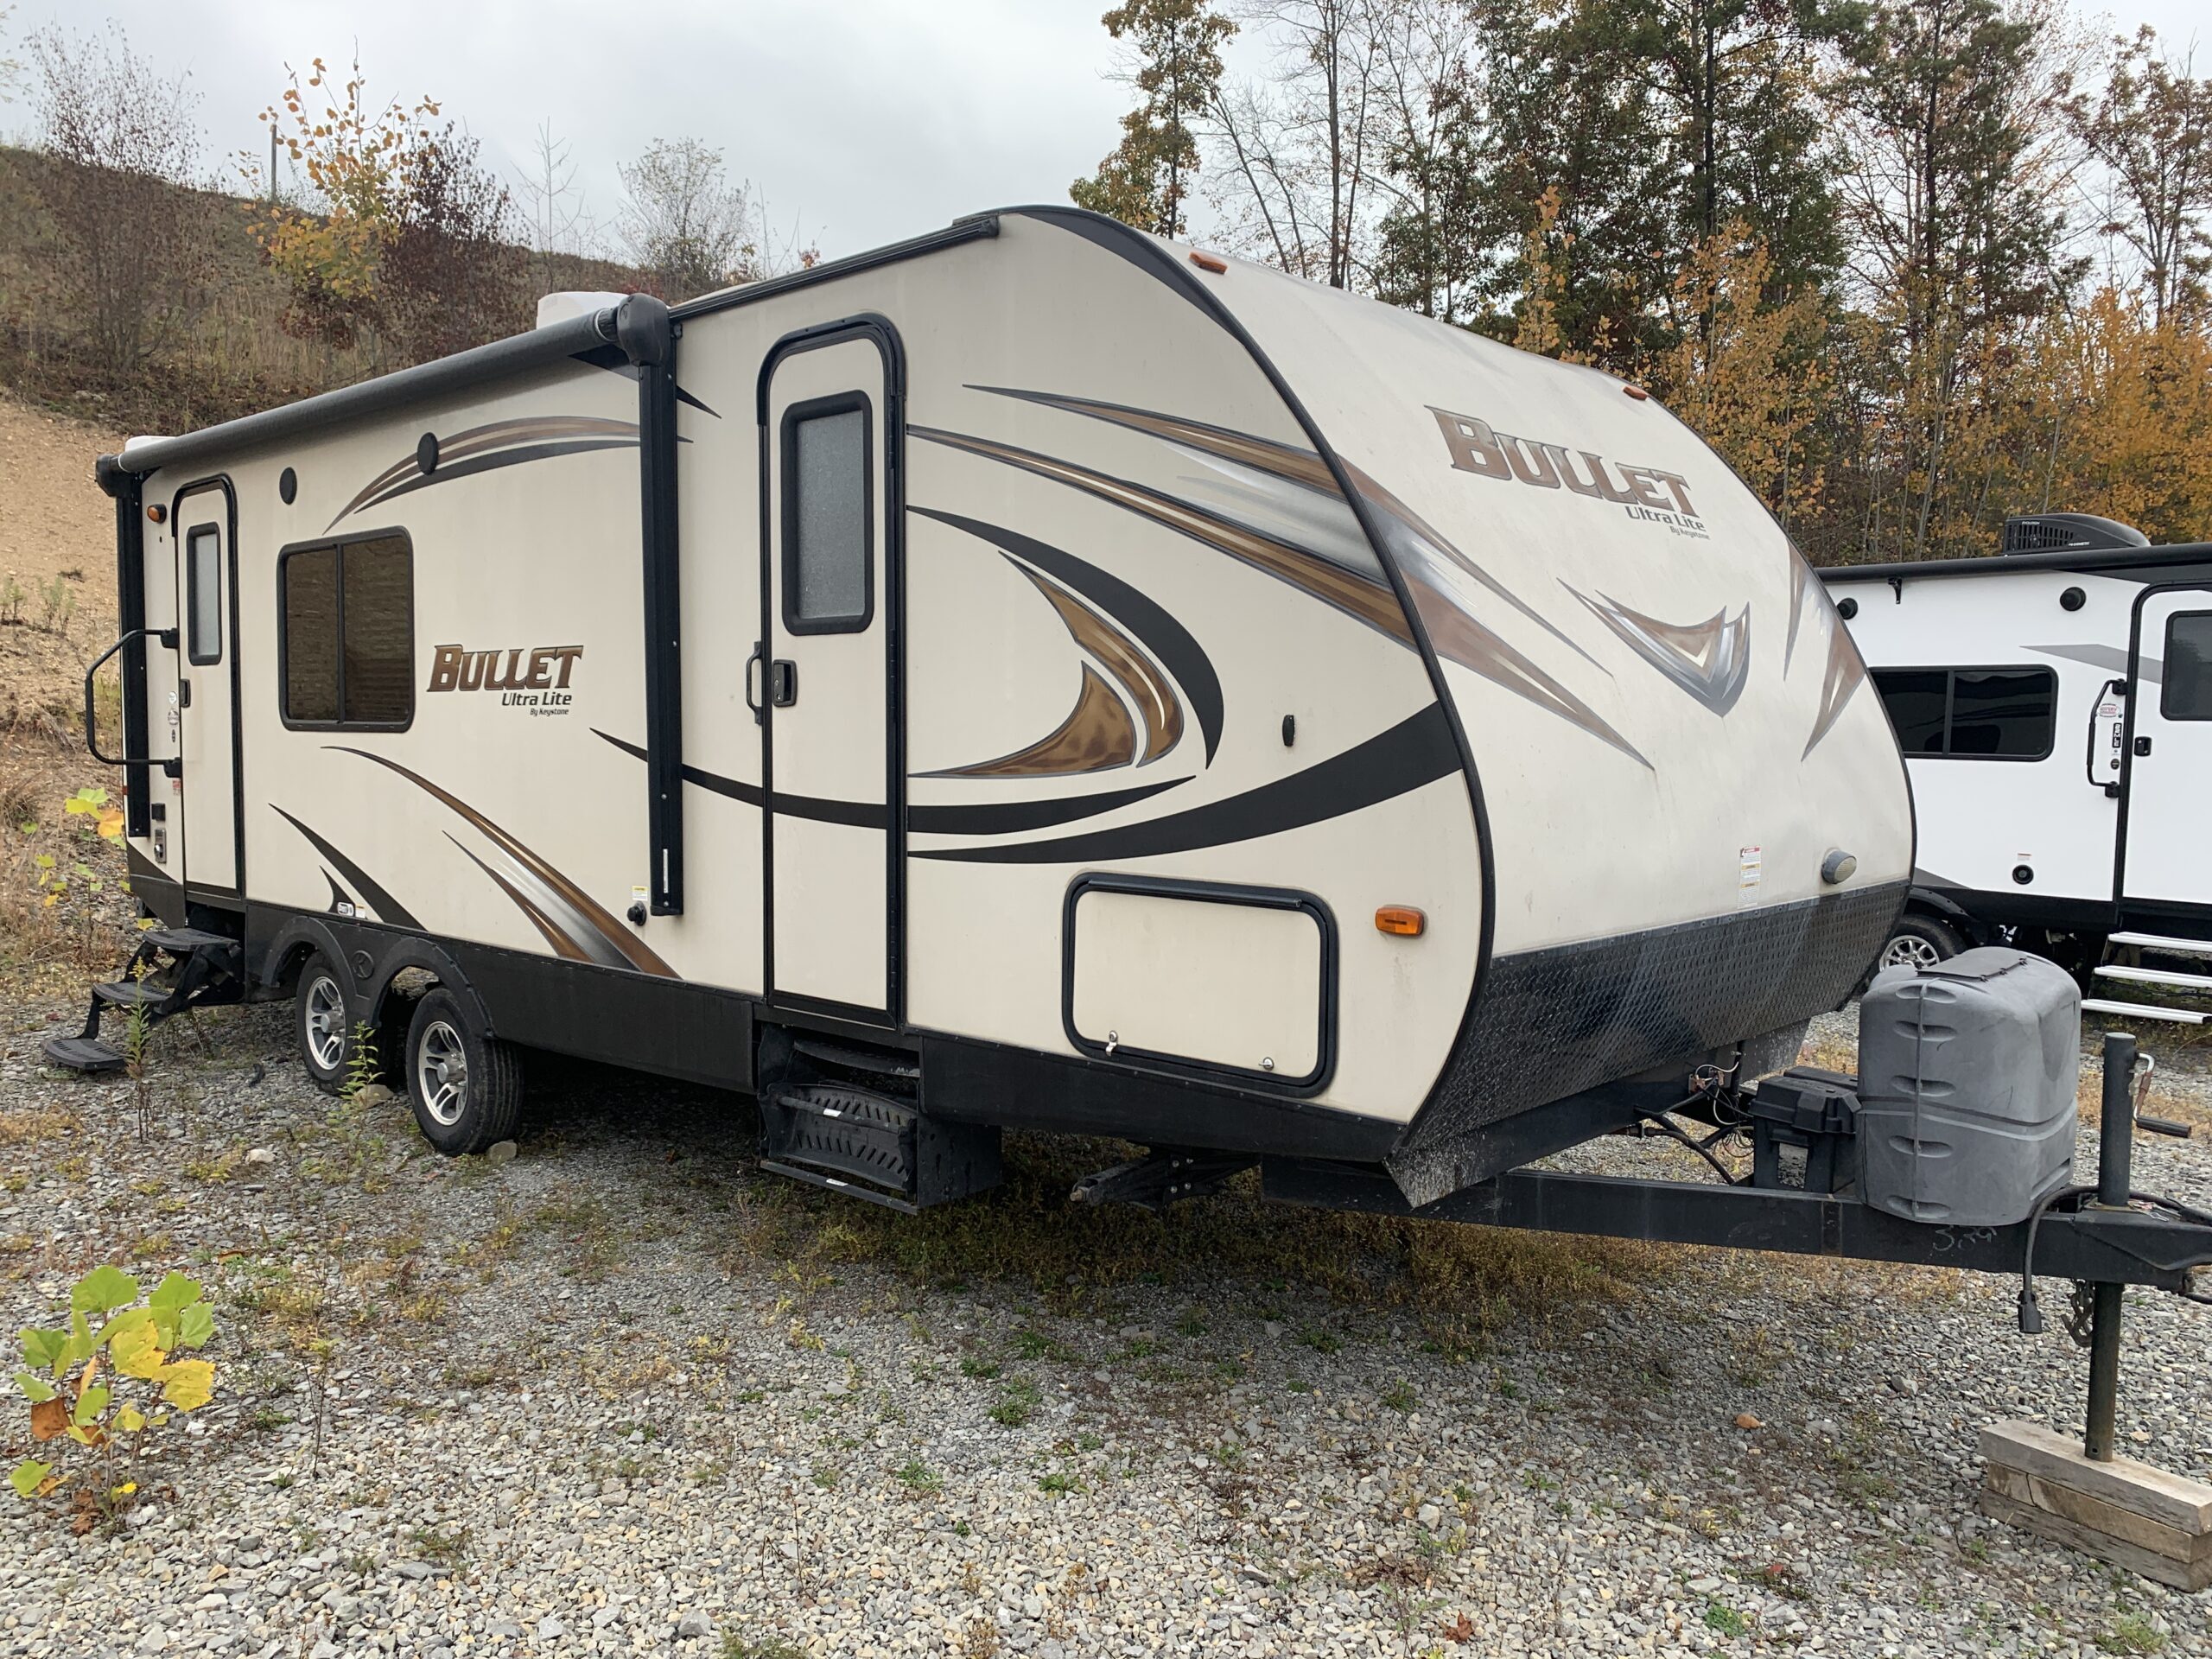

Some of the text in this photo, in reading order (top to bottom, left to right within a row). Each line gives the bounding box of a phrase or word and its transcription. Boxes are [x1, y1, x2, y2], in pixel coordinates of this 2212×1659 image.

[1424, 404, 1700, 518] BULLET
[1624, 505, 1707, 532] Ultra Lite
[1669, 525, 1681, 536] By
[426, 644, 584, 692] BULLET
[501, 691, 572, 706] Ultra Lite
[530, 708, 569, 716] By Keystone
